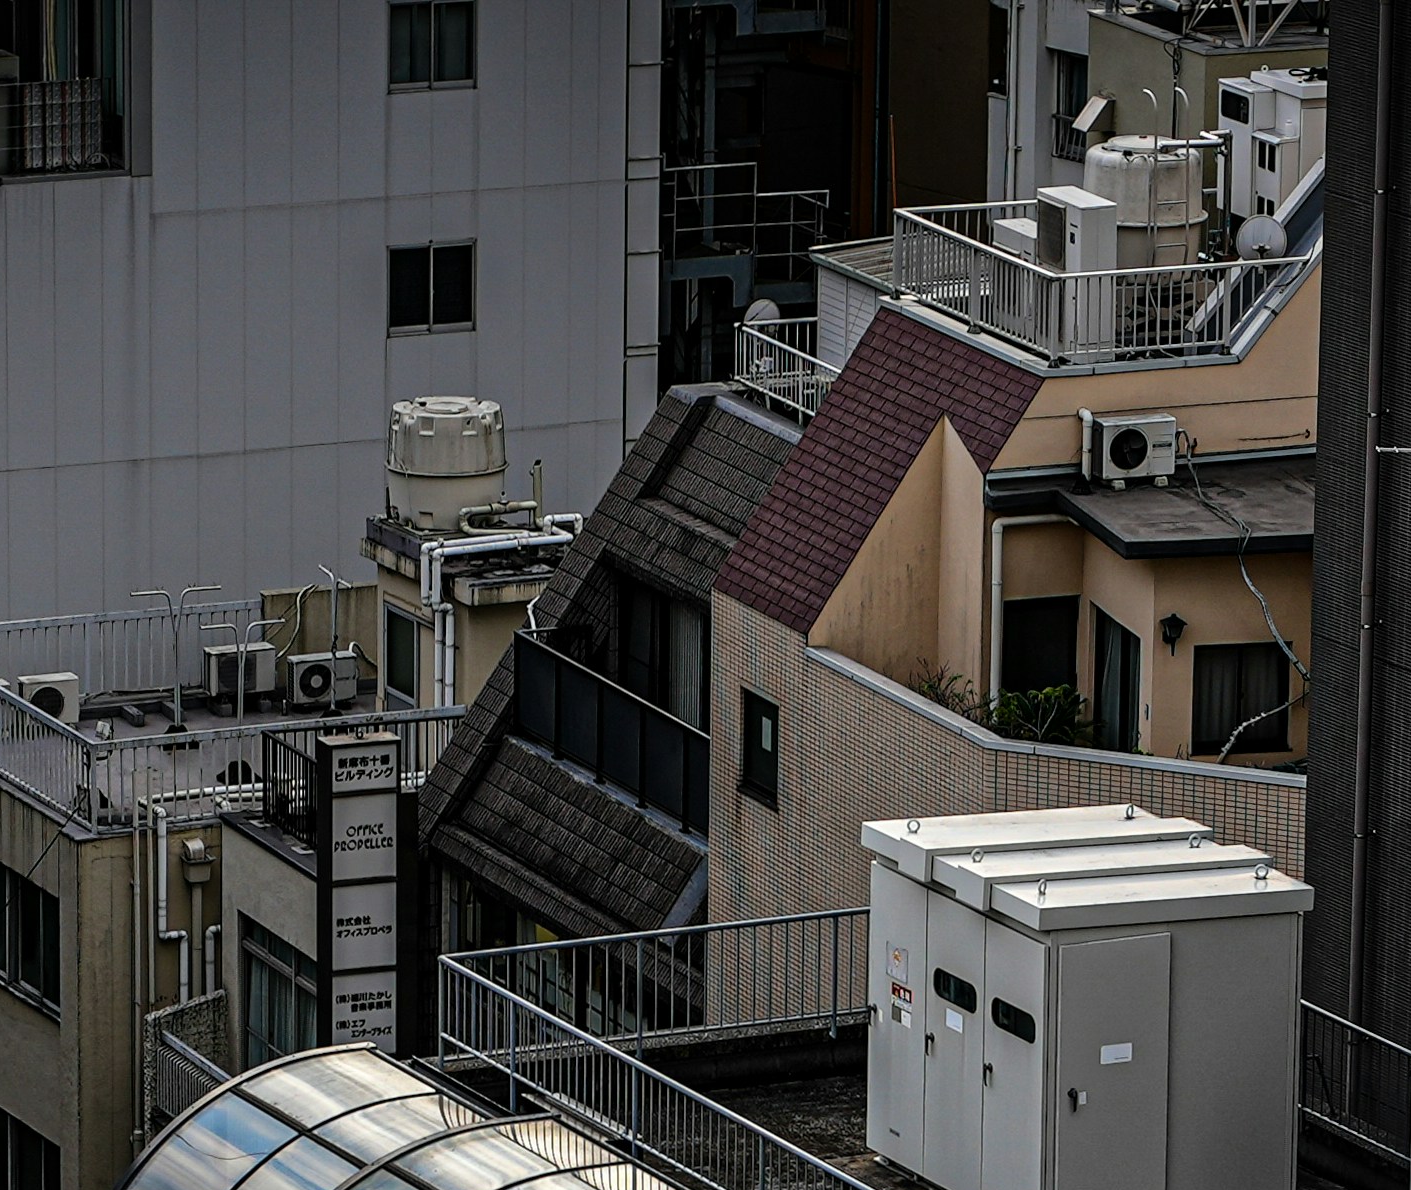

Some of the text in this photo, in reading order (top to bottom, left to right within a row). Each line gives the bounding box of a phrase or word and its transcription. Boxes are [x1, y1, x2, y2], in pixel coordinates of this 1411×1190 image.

[334, 765, 394, 782] ビルディング
[345, 822, 384, 837] OFFICE
[333, 836, 393, 852] PROPELLER
[336, 915, 372, 926] 株式会社
